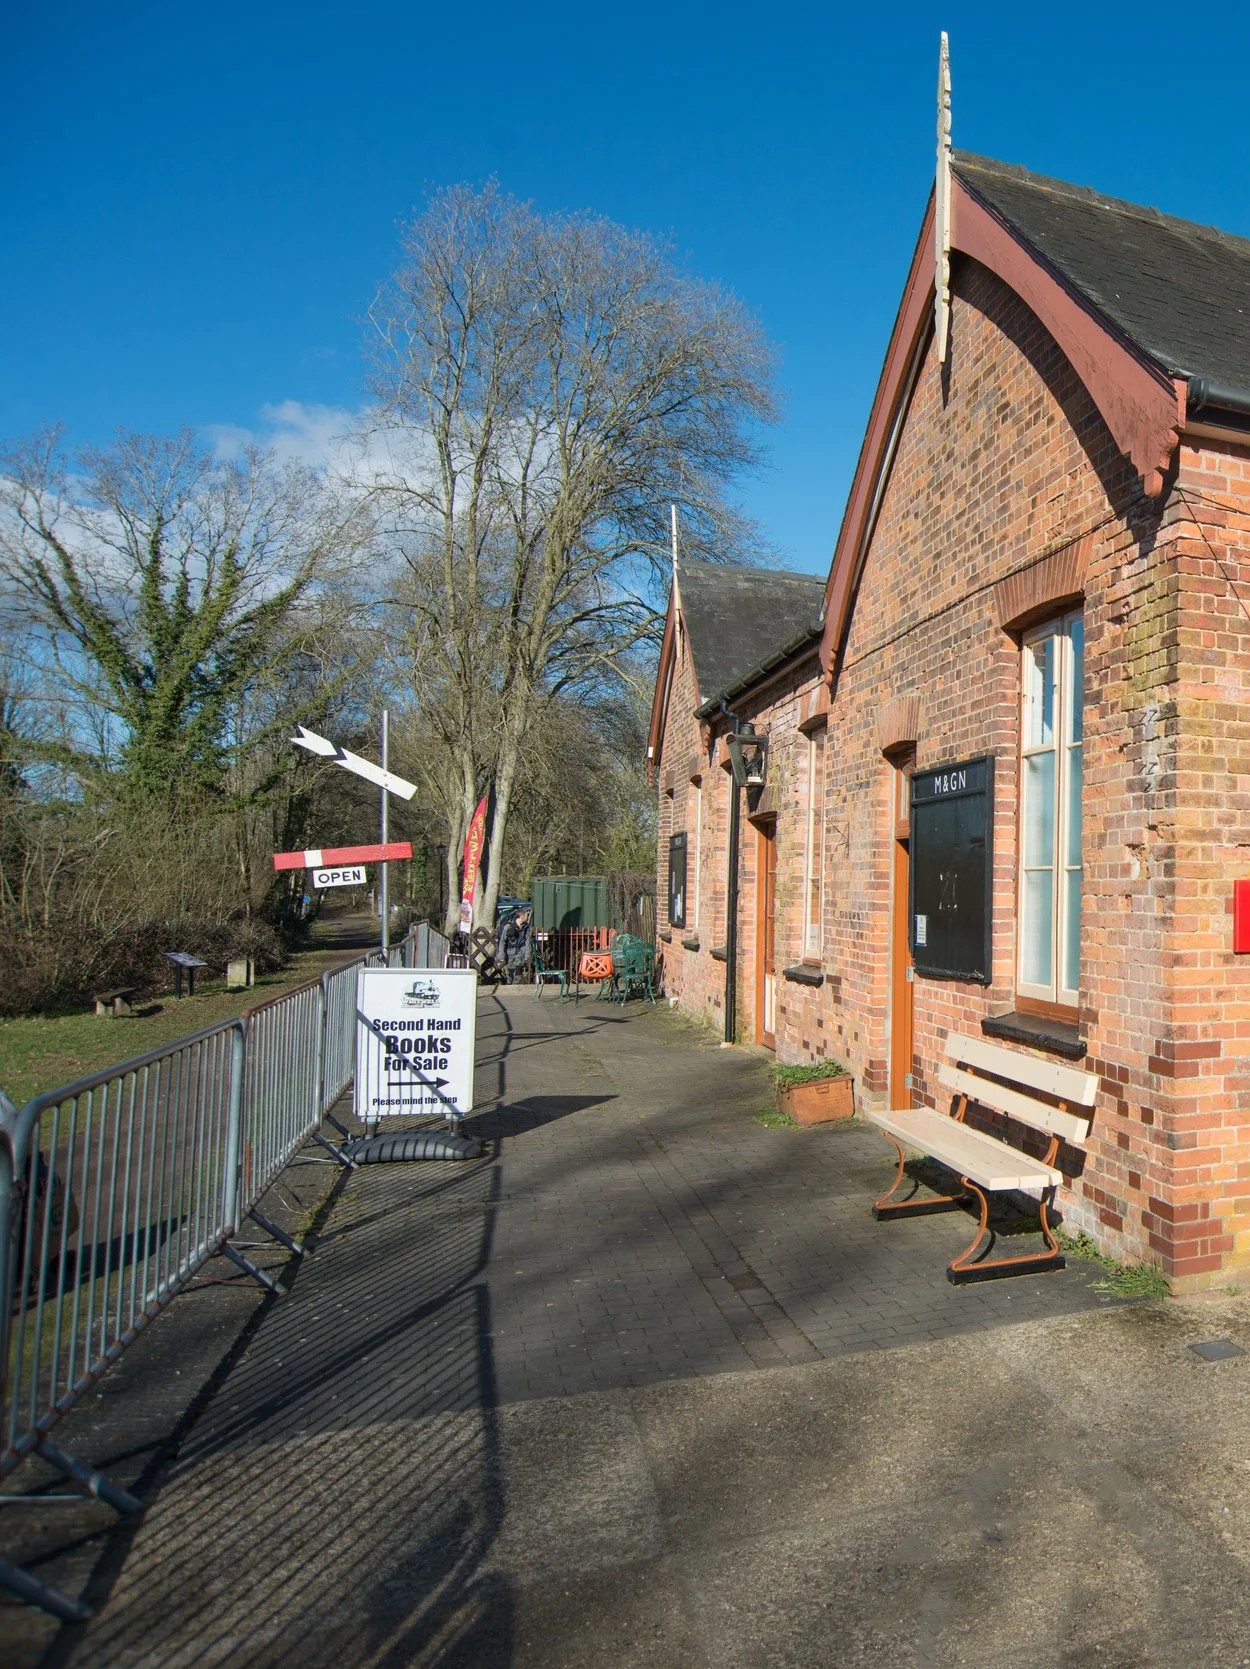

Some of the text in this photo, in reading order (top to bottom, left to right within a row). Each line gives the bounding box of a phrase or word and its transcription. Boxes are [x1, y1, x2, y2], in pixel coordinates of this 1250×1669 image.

[934, 769, 967, 794] M&GN
[318, 869, 361, 884] OPEN
[372, 1018, 461, 1032] Second Hand
[385, 1034, 452, 1055] Books
[384, 1055, 448, 1072] For Sale
[372, 1096, 458, 1106] Please mind the step
